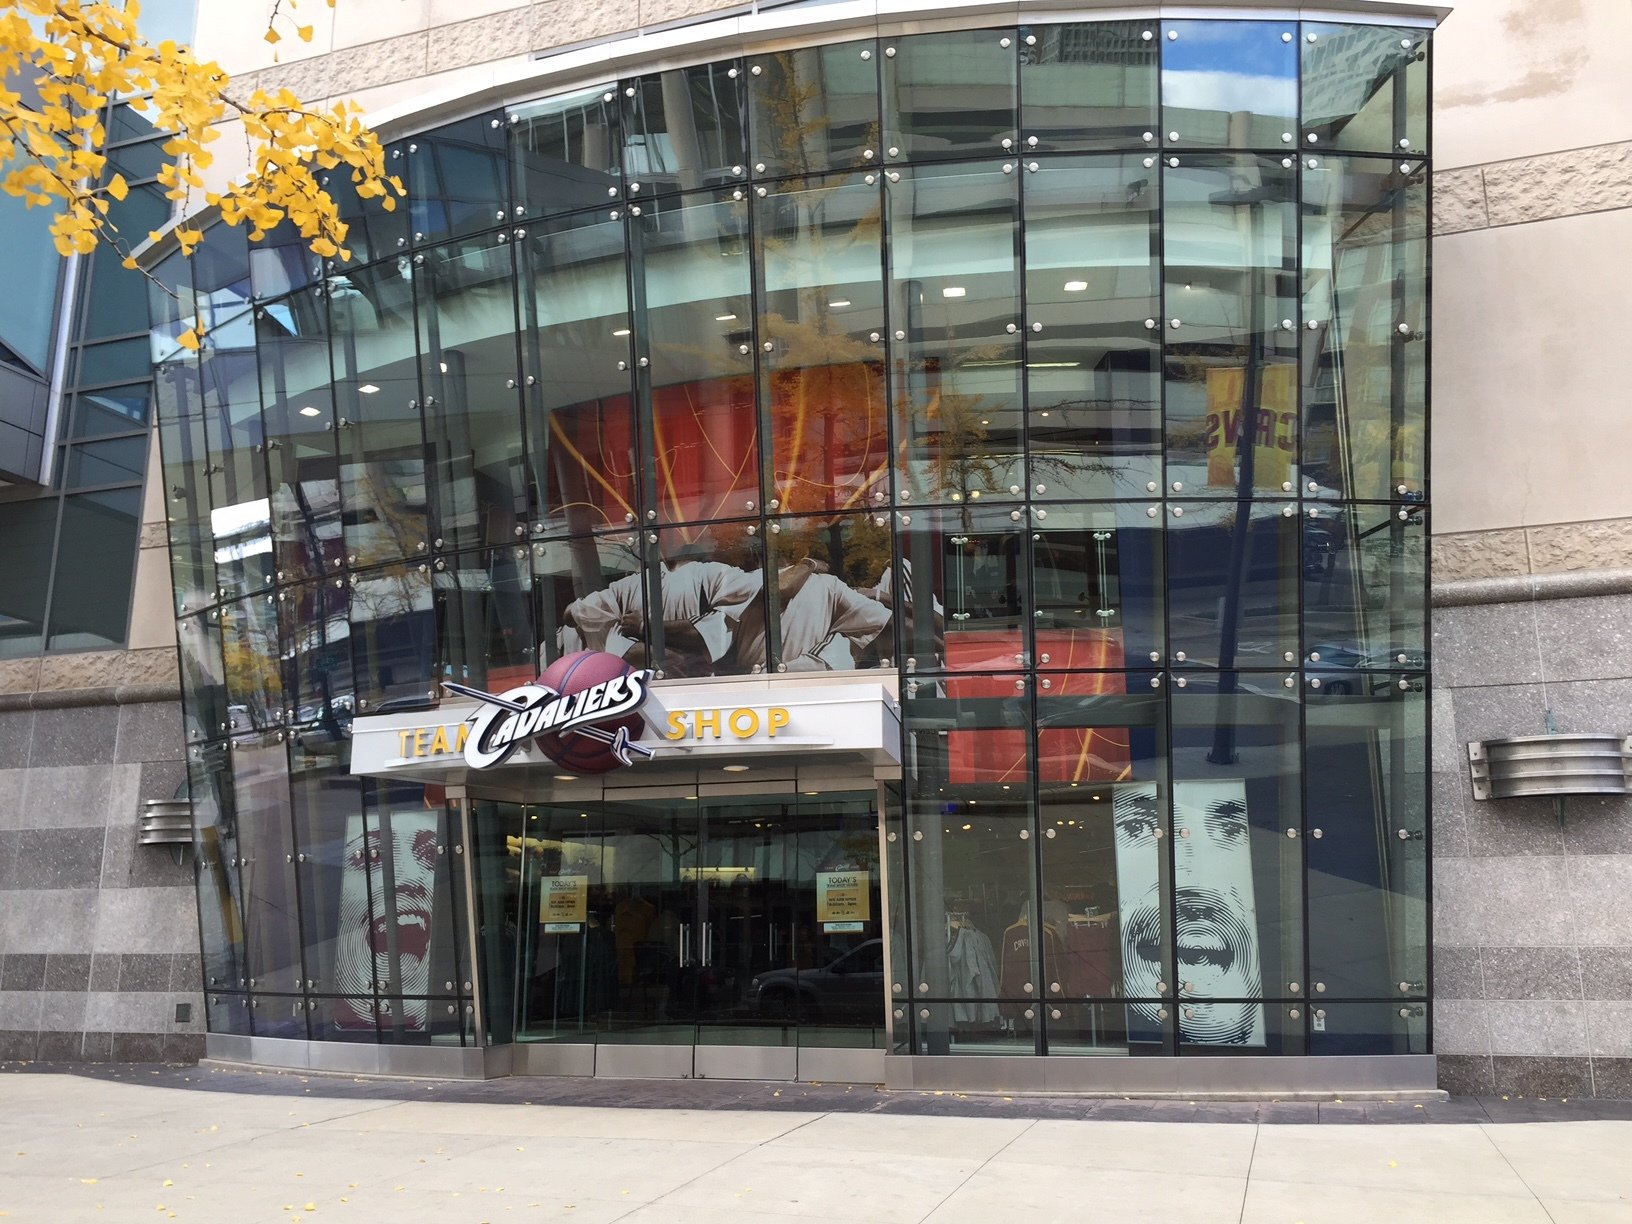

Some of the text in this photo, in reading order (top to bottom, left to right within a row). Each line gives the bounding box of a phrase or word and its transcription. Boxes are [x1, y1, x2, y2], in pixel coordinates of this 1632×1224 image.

[464, 668, 656, 769] CAVALIERS
[665, 707, 790, 740] SHOP
[828, 876, 857, 884] TODAY'S
